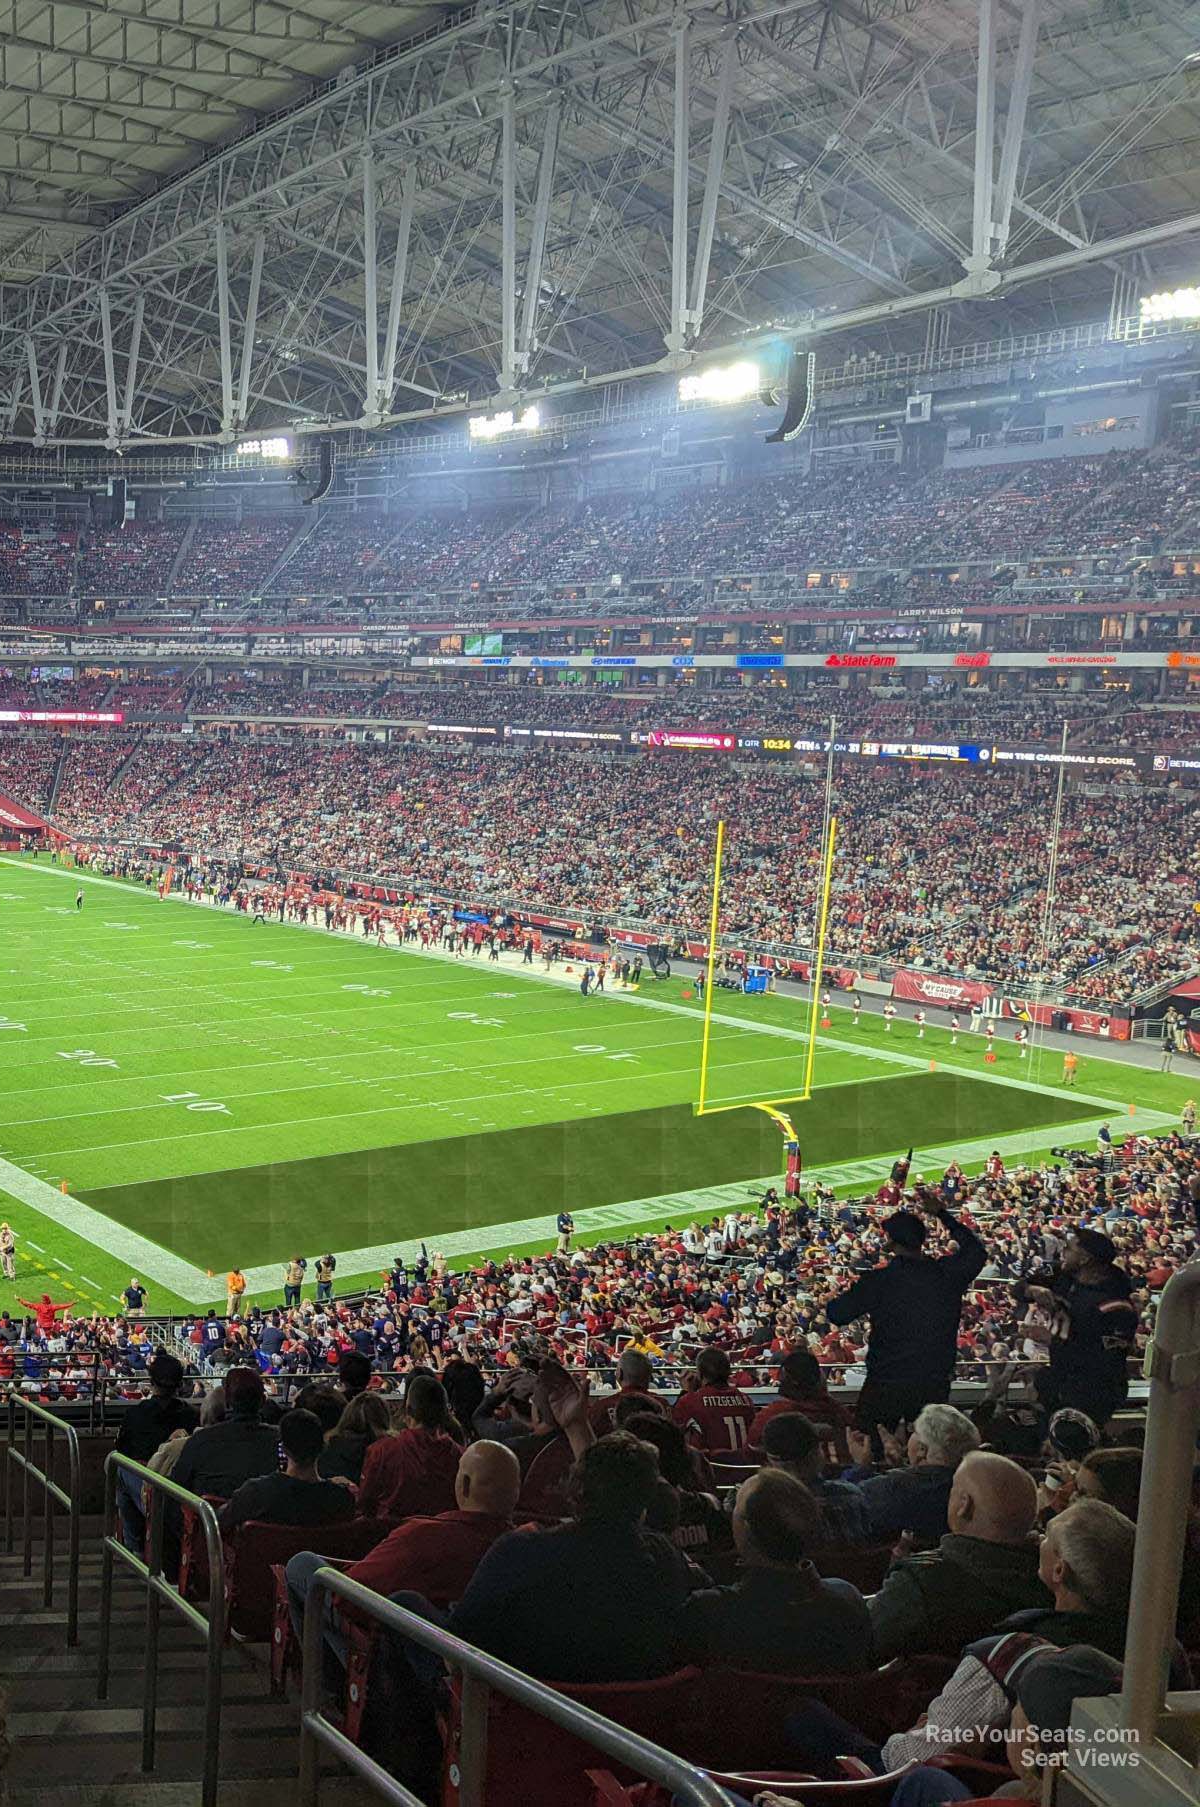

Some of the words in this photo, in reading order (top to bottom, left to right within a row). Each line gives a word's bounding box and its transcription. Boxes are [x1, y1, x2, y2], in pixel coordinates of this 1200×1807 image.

[898, 609, 928, 617] LARRY
[928, 607, 964, 616] WILSON
[672, 656, 695, 666] COX
[737, 739, 743, 748] 1
[744, 740, 759, 748] QTR
[763, 740, 791, 750] 10:34
[793, 740, 815, 751] 4TH
[823, 742, 830, 752] 7
[1015, 753, 1034, 761] THE
[1036, 753, 1095, 764] CARDINALS
[1097, 756, 1137, 767] SCORE,
[937, 984, 960, 995] CAUSE
[56, 1049, 117, 1069] 20
[158, 1090, 227, 1112] 10
[207, 1327, 219, 1340] 10
[250, 1323, 264, 1335] 37
[722, 1416, 748, 1451] 11
